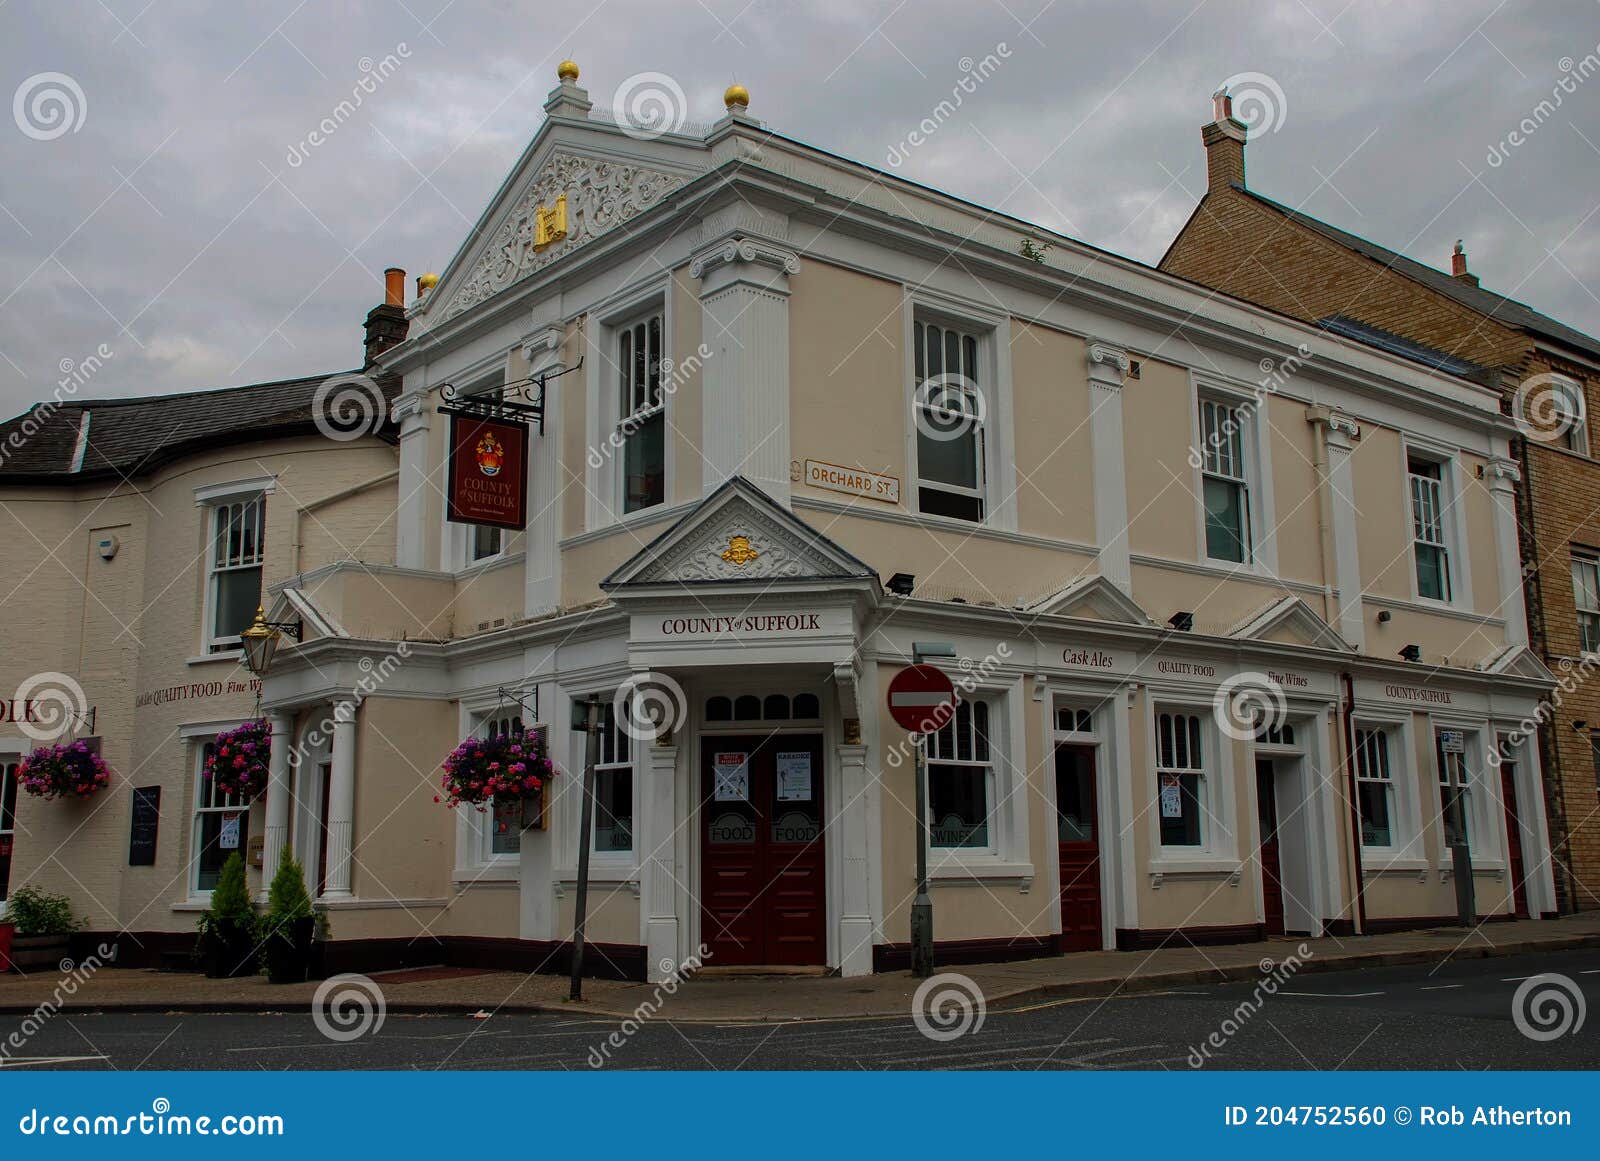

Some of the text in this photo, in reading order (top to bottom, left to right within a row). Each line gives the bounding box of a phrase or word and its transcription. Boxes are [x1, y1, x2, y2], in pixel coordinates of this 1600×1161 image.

[464, 478, 511, 495] COUNTY
[811, 467, 894, 496] ORCHARD ST.
[467, 490, 515, 508] SUFFOLK
[662, 615, 735, 635] COUNTY
[744, 613, 820, 632] SUFFOLK
[1062, 648, 1113, 668] Cask Ales
[1158, 661, 1215, 677] QUALITY FOOD
[1267, 670, 1308, 687] Fine Wines
[153, 684, 189, 706] QUALITY
[190, 681, 223, 699] FOOD
[227, 680, 246, 694] Fine
[1385, 685, 1418, 700] COUNTY
[1420, 689, 1452, 704] SUFFOLK
[712, 826, 753, 841] FOOD
[775, 826, 817, 841] FOOD
